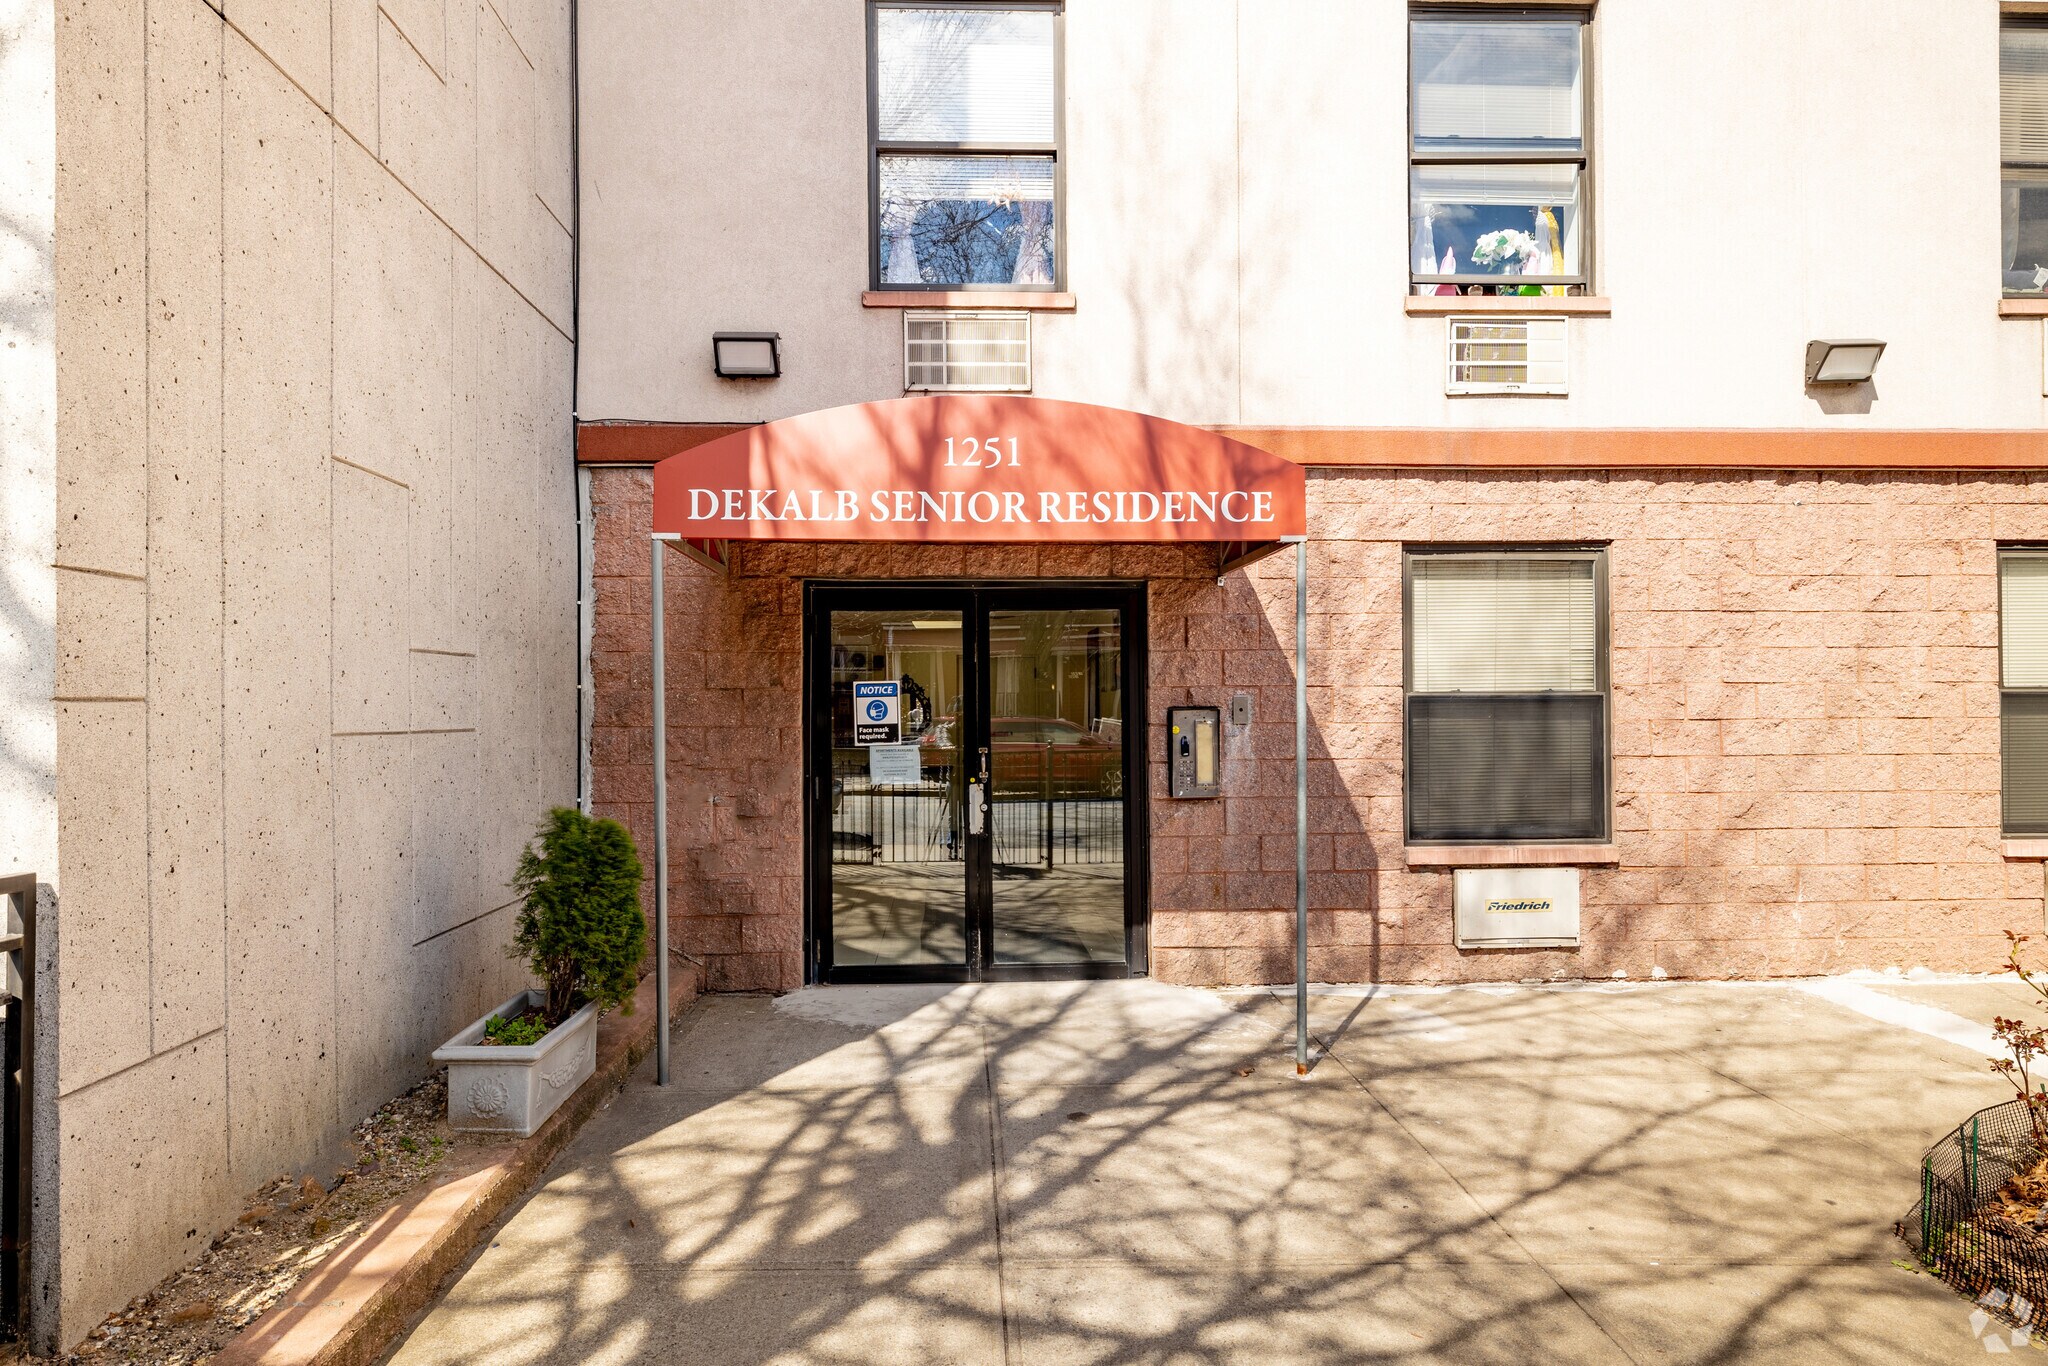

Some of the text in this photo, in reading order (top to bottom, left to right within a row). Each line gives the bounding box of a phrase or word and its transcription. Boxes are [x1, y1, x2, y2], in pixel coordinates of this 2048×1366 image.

[943, 437, 1020, 468] 1251
[688, 489, 1275, 523] DEKALB SENIOR RESIDENCE
[860, 686, 893, 694] NOTICE
[1488, 902, 1550, 911] Friedrich
